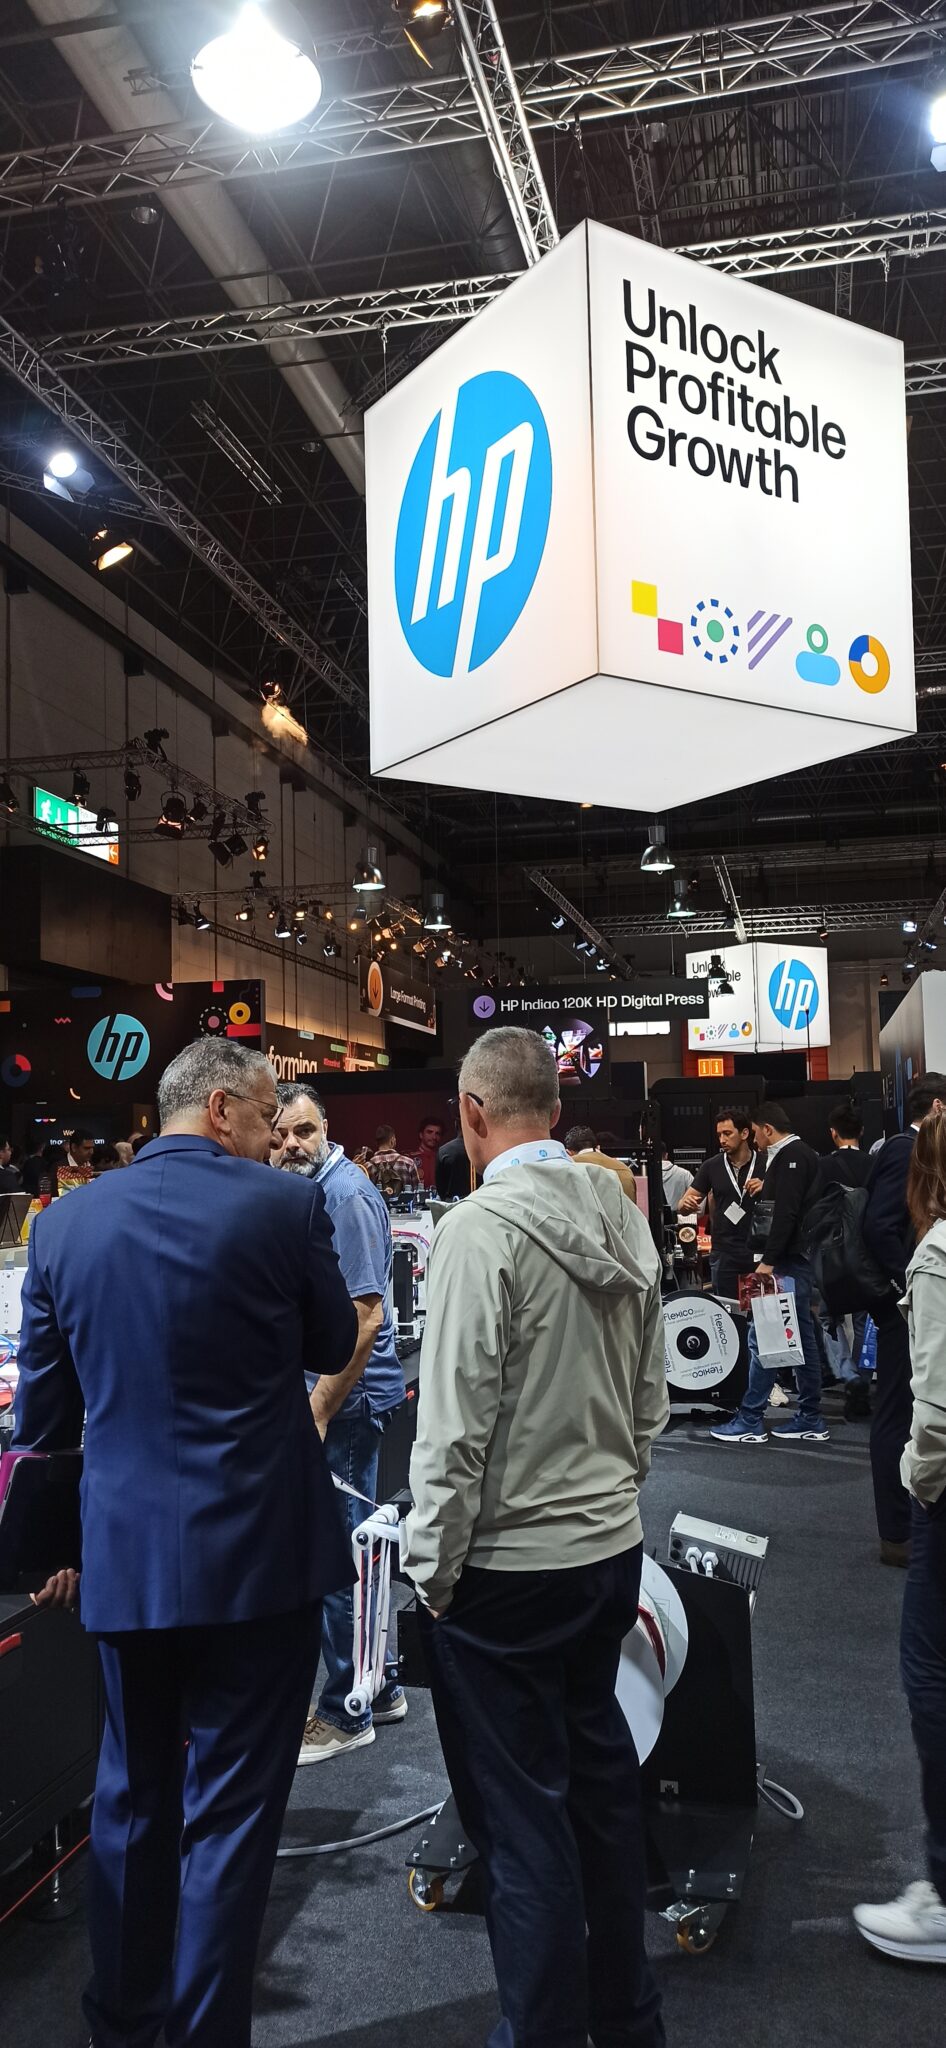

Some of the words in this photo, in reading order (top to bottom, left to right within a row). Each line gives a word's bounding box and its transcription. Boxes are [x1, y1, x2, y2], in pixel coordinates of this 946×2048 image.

[623, 279, 782, 385] Unlock
[625, 340, 846, 460] Profitable
[627, 405, 799, 503] Growth
[408, 380, 534, 679] hp
[500, 1000, 519, 1012] HP
[562, 997, 593, 1009] 120K
[596, 996, 618, 1008] HD
[621, 994, 663, 1010] Digital
[665, 993, 704, 1006] Press
[774, 959, 815, 1030] hp
[94, 1013, 145, 1081] hp
